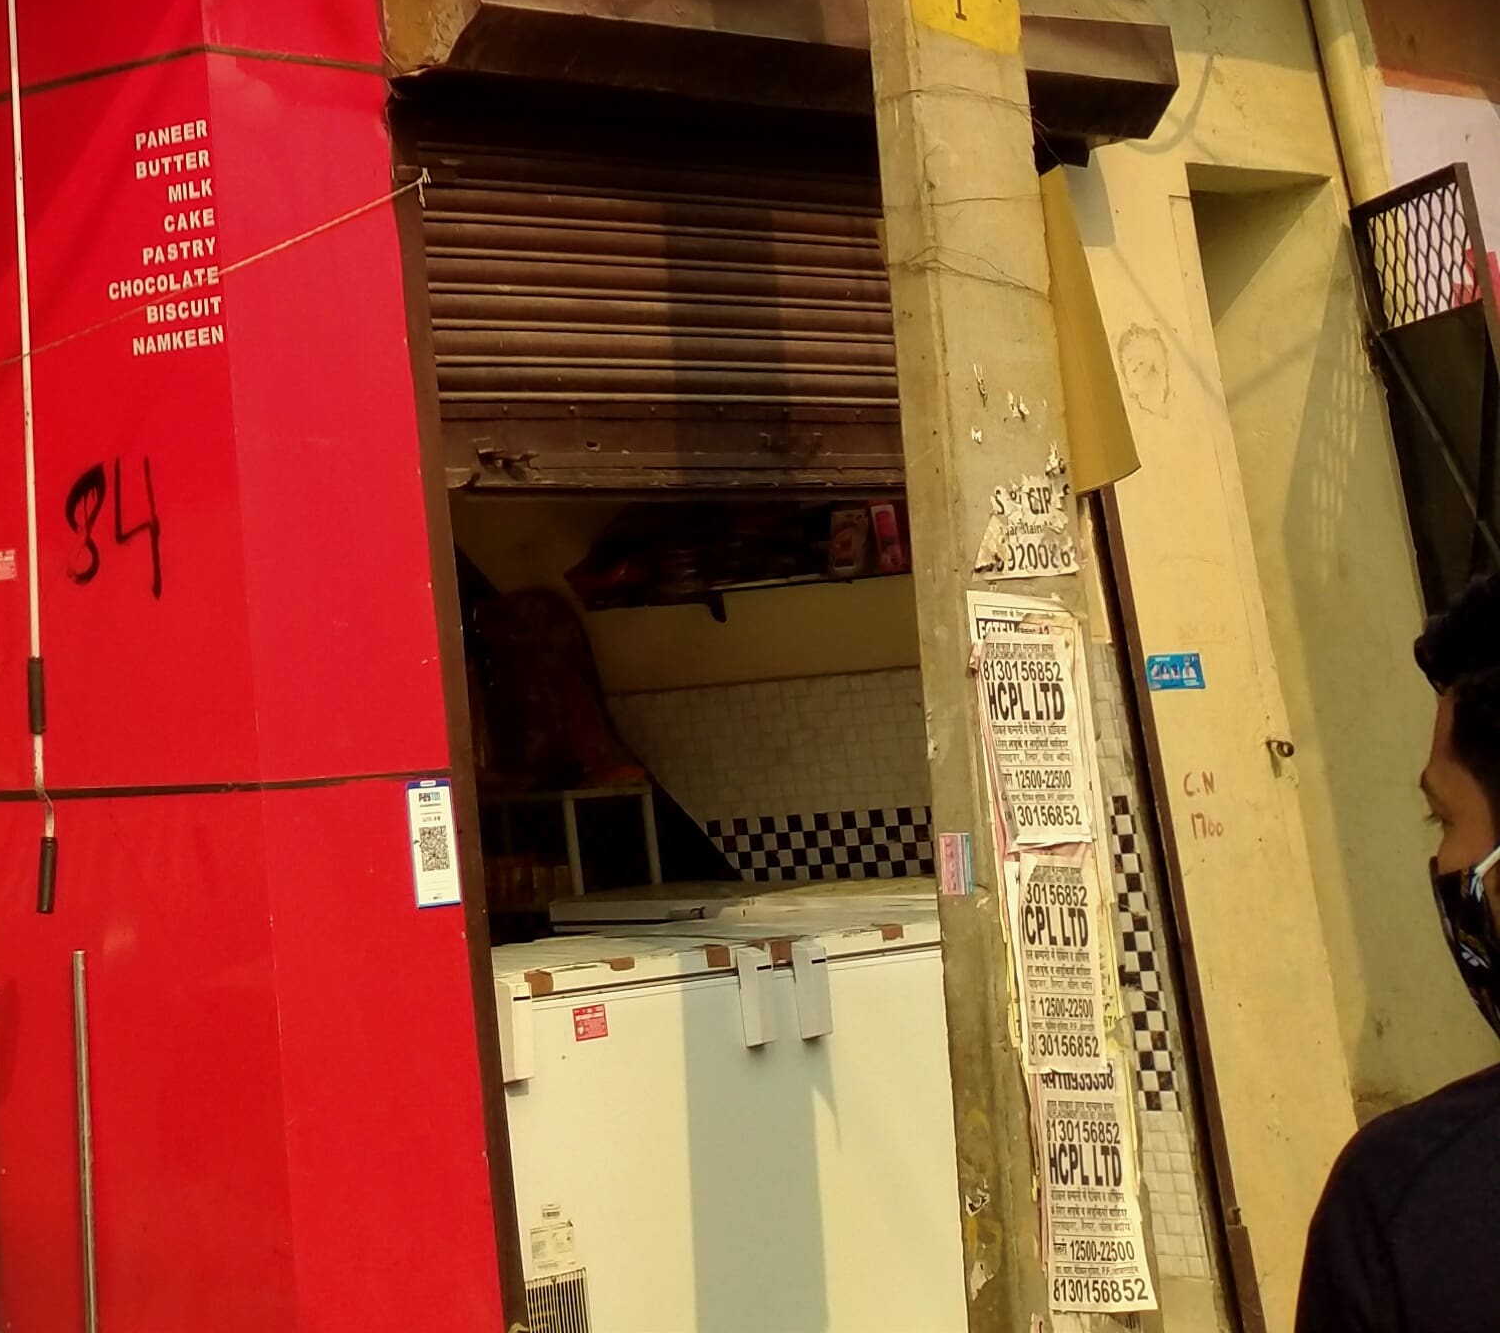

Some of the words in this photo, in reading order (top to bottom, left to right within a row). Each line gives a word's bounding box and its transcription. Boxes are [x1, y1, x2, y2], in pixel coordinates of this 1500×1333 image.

[135, 119, 208, 150] PANEER
[135, 150, 210, 180] BUTTER
[167, 179, 214, 204] MILK
[163, 208, 216, 233] CAKE
[142, 237, 217, 266] PASTRY
[108, 266, 220, 301] CHOCOLATE
[146, 296, 222, 325] BISCUIT
[132, 325, 225, 357] NAMKEEN
[983, 660, 1064, 682] 8130156852
[987, 682, 1031, 721] HCPL
[1032, 682, 1066, 721] LTD
[1014, 769, 1072, 789] 12500-22500
[1059, 906, 1089, 948] LTD
[1038, 996, 1094, 1019] 12500-22500
[1046, 1119, 1121, 1144] 8130156852
[1048, 1142, 1090, 1185] HCPL
[1092, 1144, 1123, 1187] LTD
[1069, 1239, 1135, 1262] 12500-22500
[1052, 1277, 1149, 1304] 8130156852
